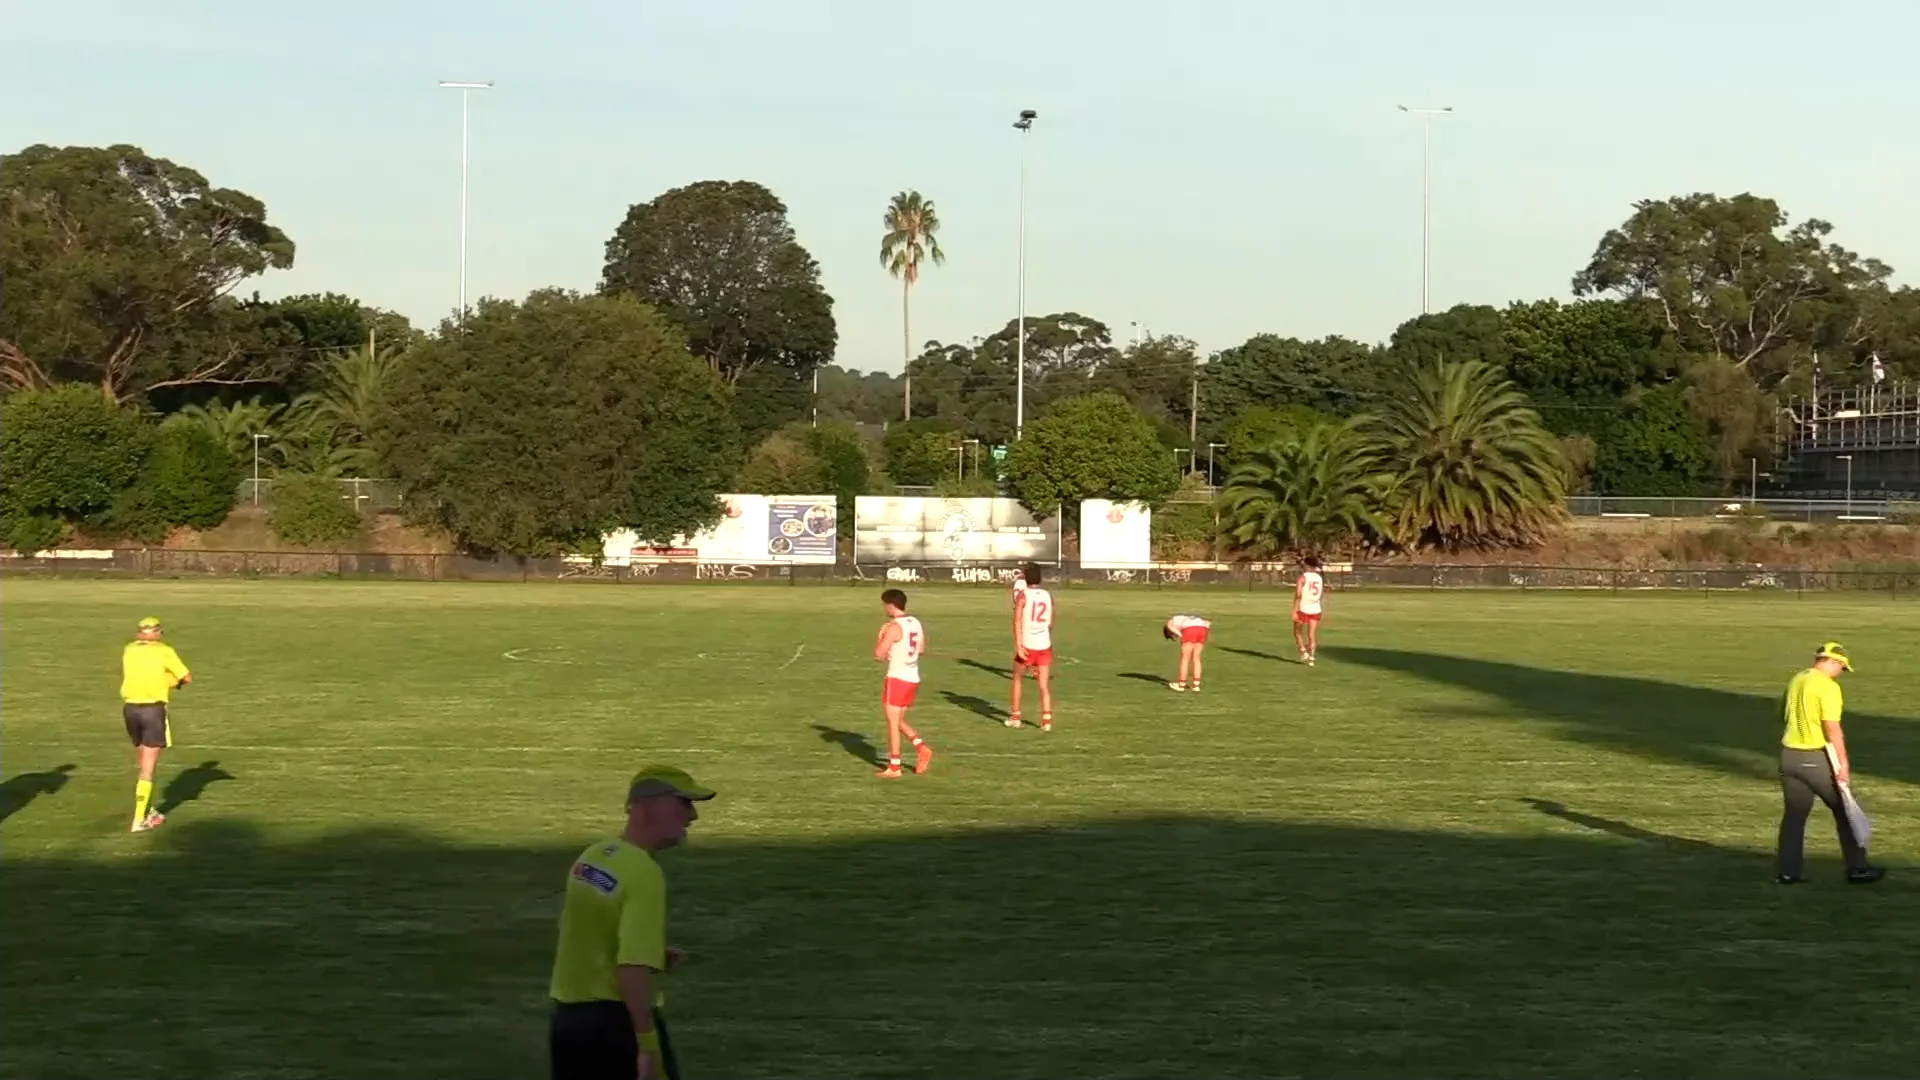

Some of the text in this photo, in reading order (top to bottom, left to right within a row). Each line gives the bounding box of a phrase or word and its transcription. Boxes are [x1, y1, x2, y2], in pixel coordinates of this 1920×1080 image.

[1309, 581, 1319, 596] 15
[1031, 600, 1047, 623] 12
[908, 631, 919, 657] 5
